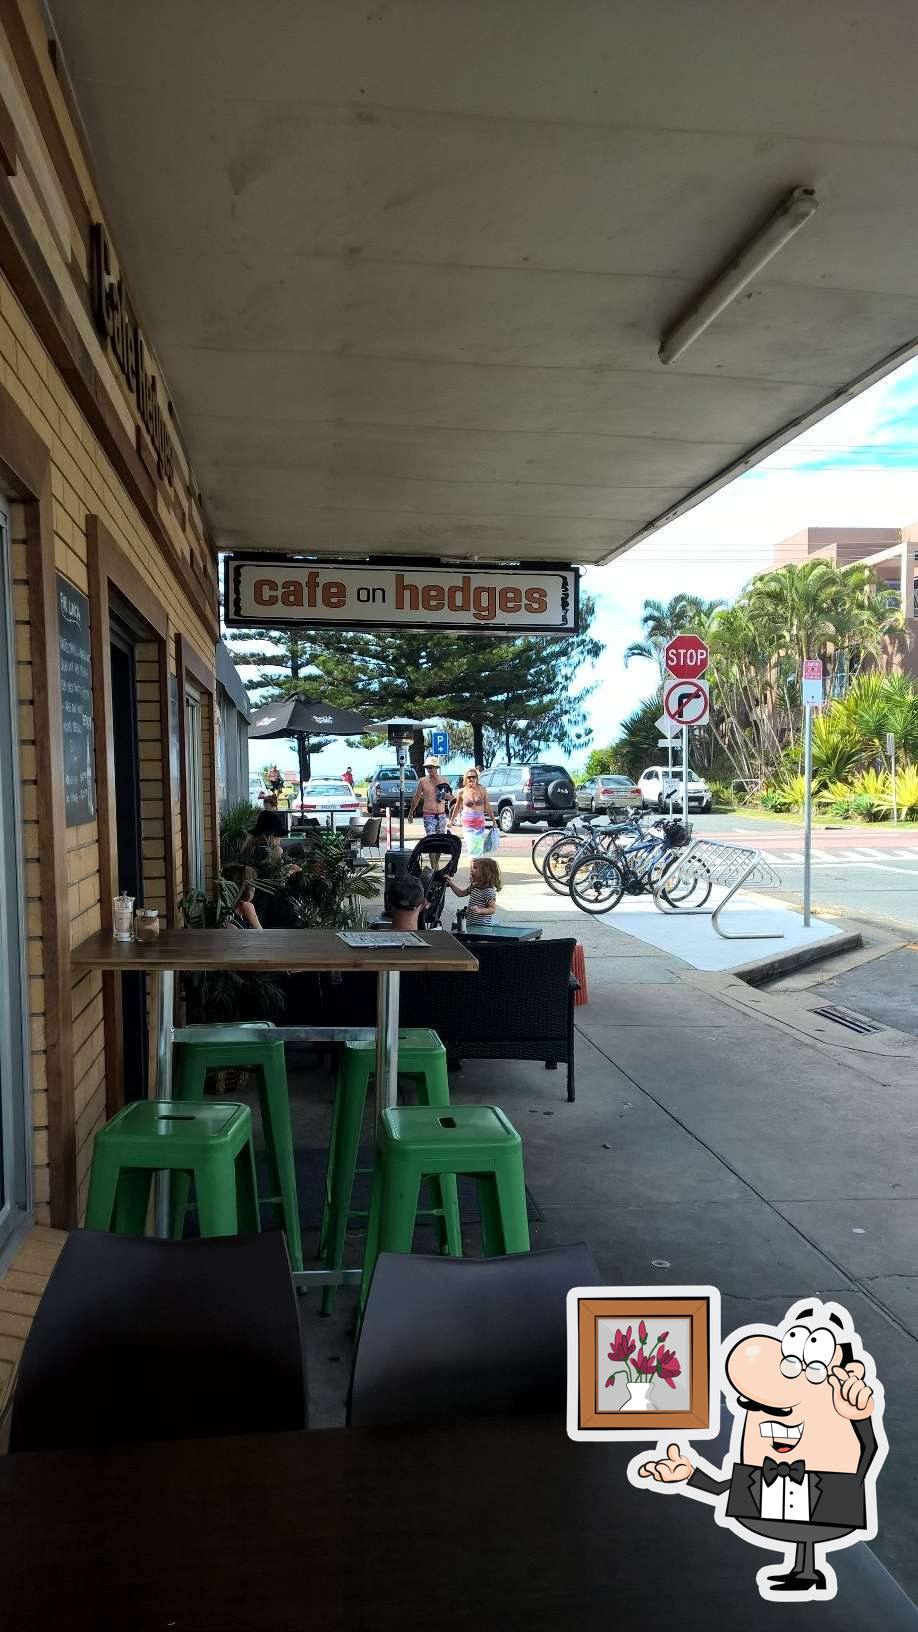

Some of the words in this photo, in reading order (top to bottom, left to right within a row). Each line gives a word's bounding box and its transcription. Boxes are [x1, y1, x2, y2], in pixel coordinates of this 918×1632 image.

[253, 571, 347, 609] cafe
[356, 586, 387, 604] on
[395, 573, 548, 621] hedges
[667, 649, 707, 666] STOP
[437, 735, 444, 746] P
